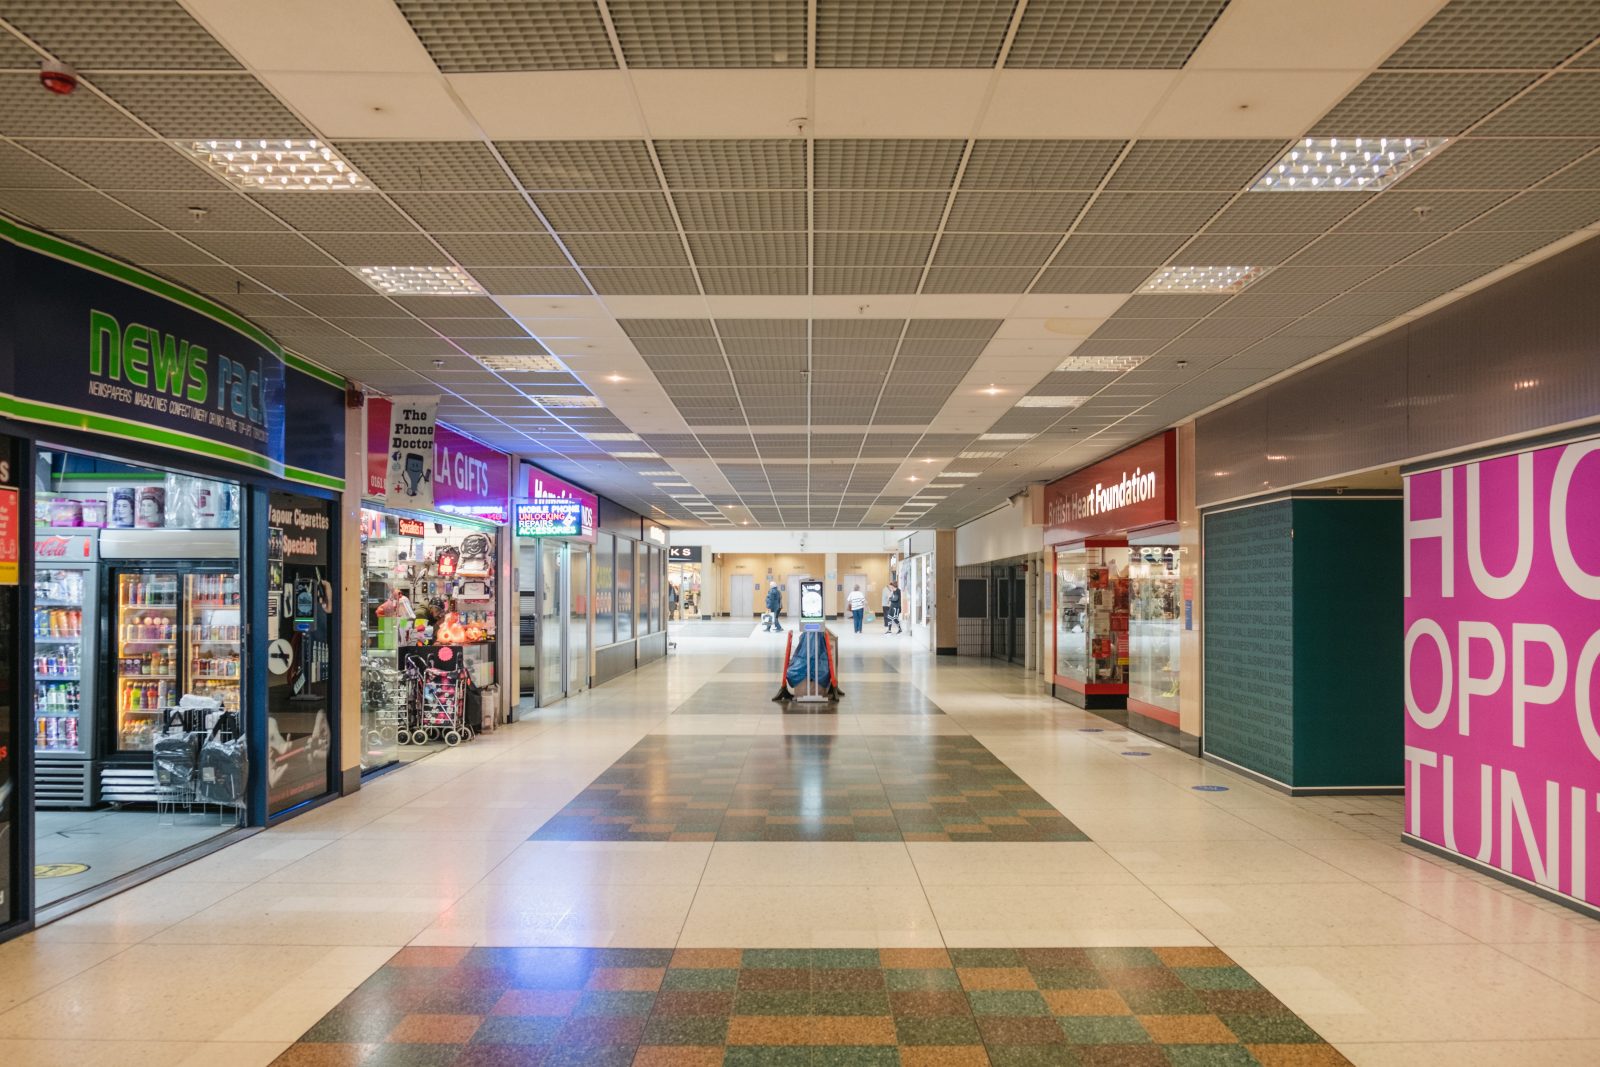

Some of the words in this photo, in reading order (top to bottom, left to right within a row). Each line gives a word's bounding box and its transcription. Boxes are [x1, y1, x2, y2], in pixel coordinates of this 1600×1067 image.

[89, 380, 132, 404] NEWSPAPERS
[134, 392, 168, 412] MAGAZINES
[169, 401, 208, 422] CONFECTIONERY
[402, 410, 427, 421] The
[394, 424, 434, 436] Phone
[392, 438, 434, 450] Doctor
[454, 452, 488, 496] GIFTS
[1048, 495, 1070, 527] British
[1072, 488, 1094, 520] Heart
[1096, 467, 1156, 514] Foundation
[294, 508, 329, 530] Cigarettes
[518, 527, 576, 535] ACCESSORIES
[283, 535, 317, 556] Specialist
[1404, 745, 1600, 902] TUNI
